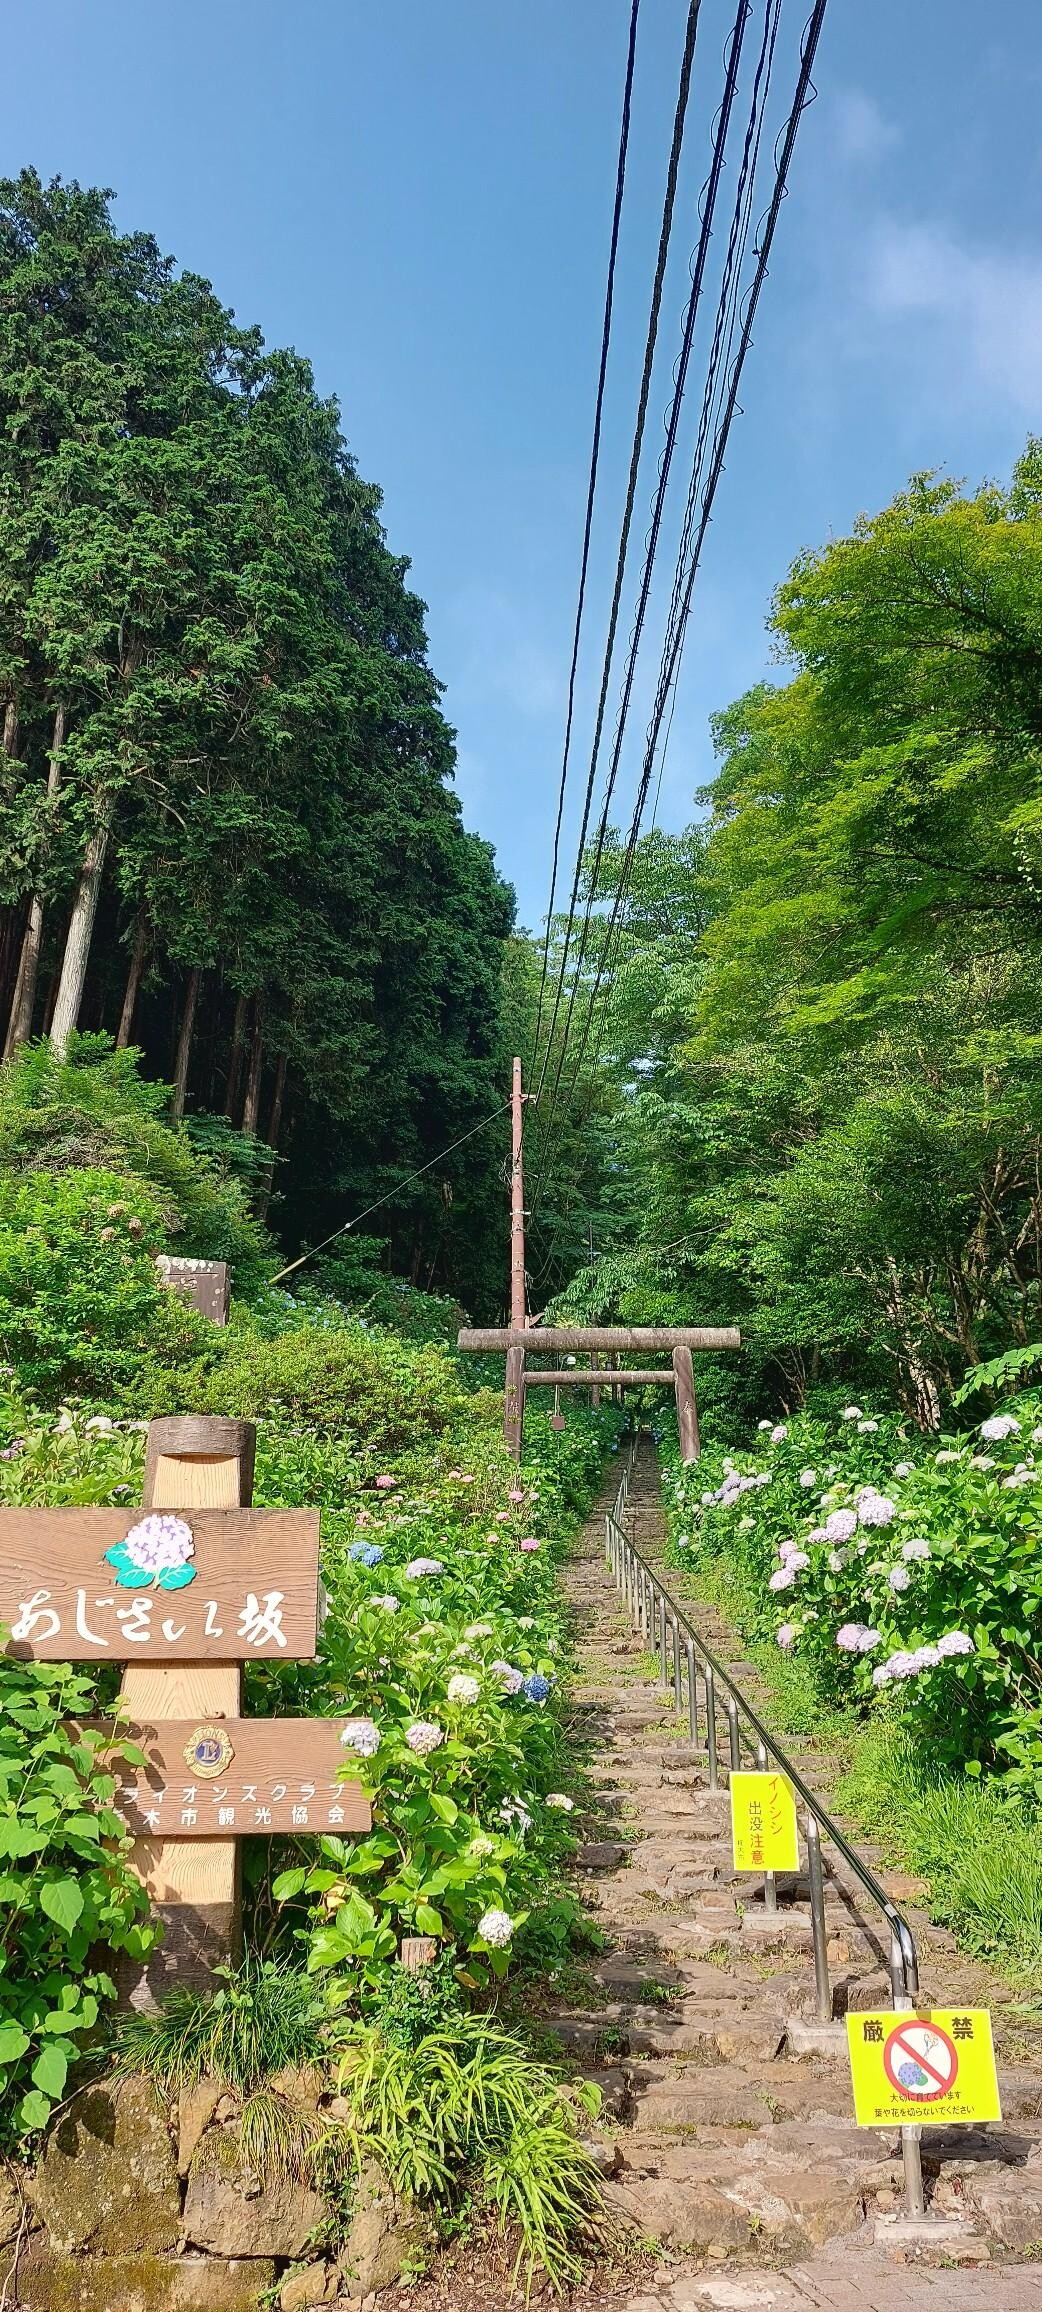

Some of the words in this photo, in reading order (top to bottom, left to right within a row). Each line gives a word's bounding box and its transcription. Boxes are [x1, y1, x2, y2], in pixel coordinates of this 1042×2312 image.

[11, 1589, 287, 1648] あじさい坂
[112, 1804, 346, 1826] 木市観光協会
[768, 1777, 783, 1835] イノシシ
[749, 1800, 765, 1865] 出没注意
[863, 2019, 884, 2042] 厳
[951, 2017, 974, 2040] 禁
[890, 2091, 962, 2103] 大切に育てています
